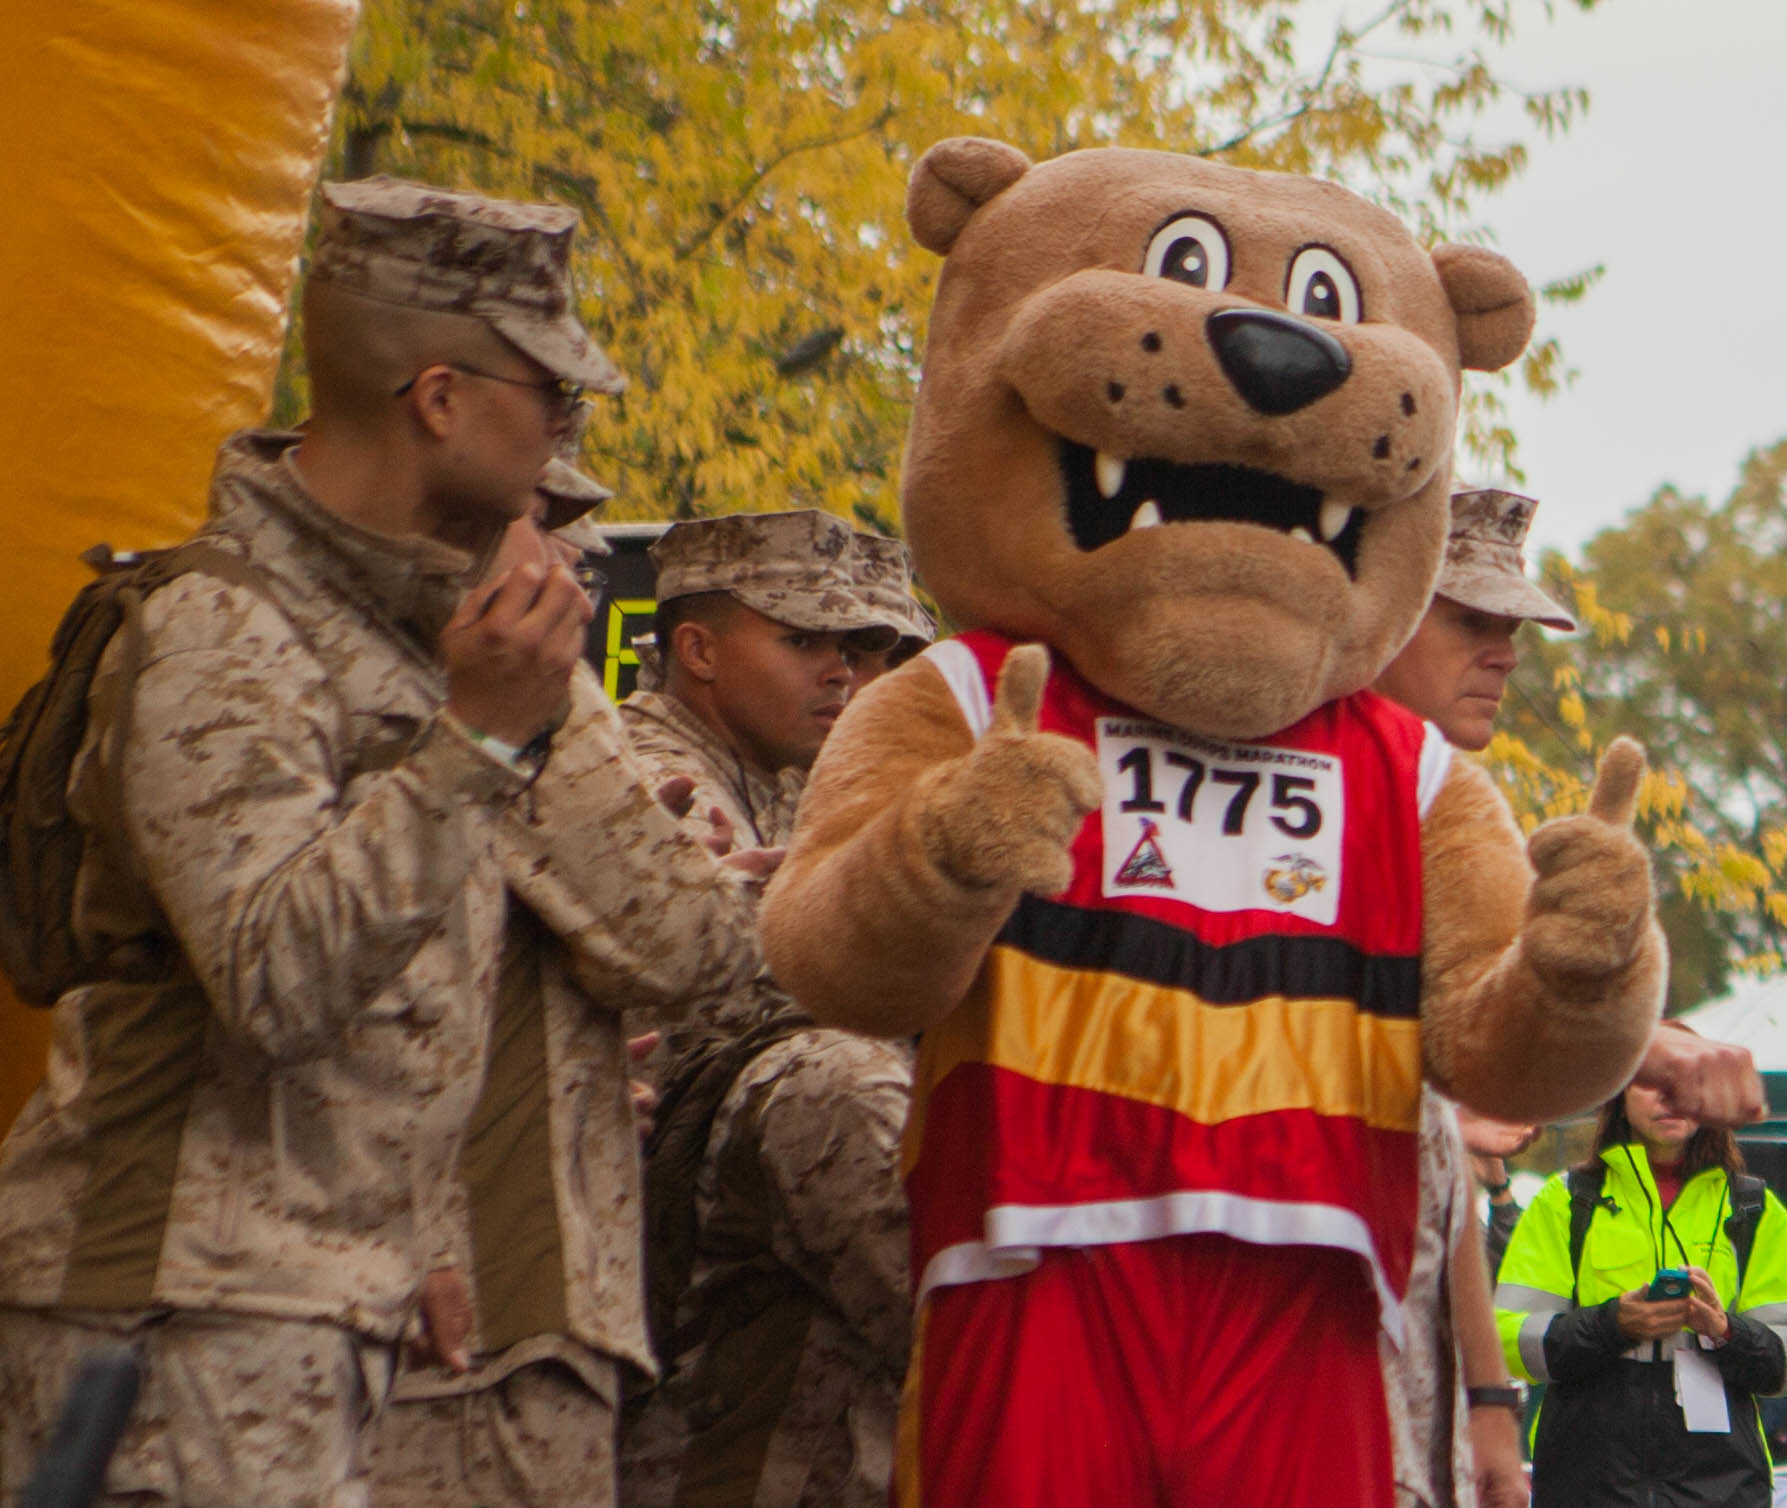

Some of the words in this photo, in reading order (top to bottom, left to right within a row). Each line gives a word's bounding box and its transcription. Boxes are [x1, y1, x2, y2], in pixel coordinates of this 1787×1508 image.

[1104, 723, 1172, 742] MARINE
[1233, 748, 1332, 772] MARATHON
[1117, 747, 1323, 840] 1775
